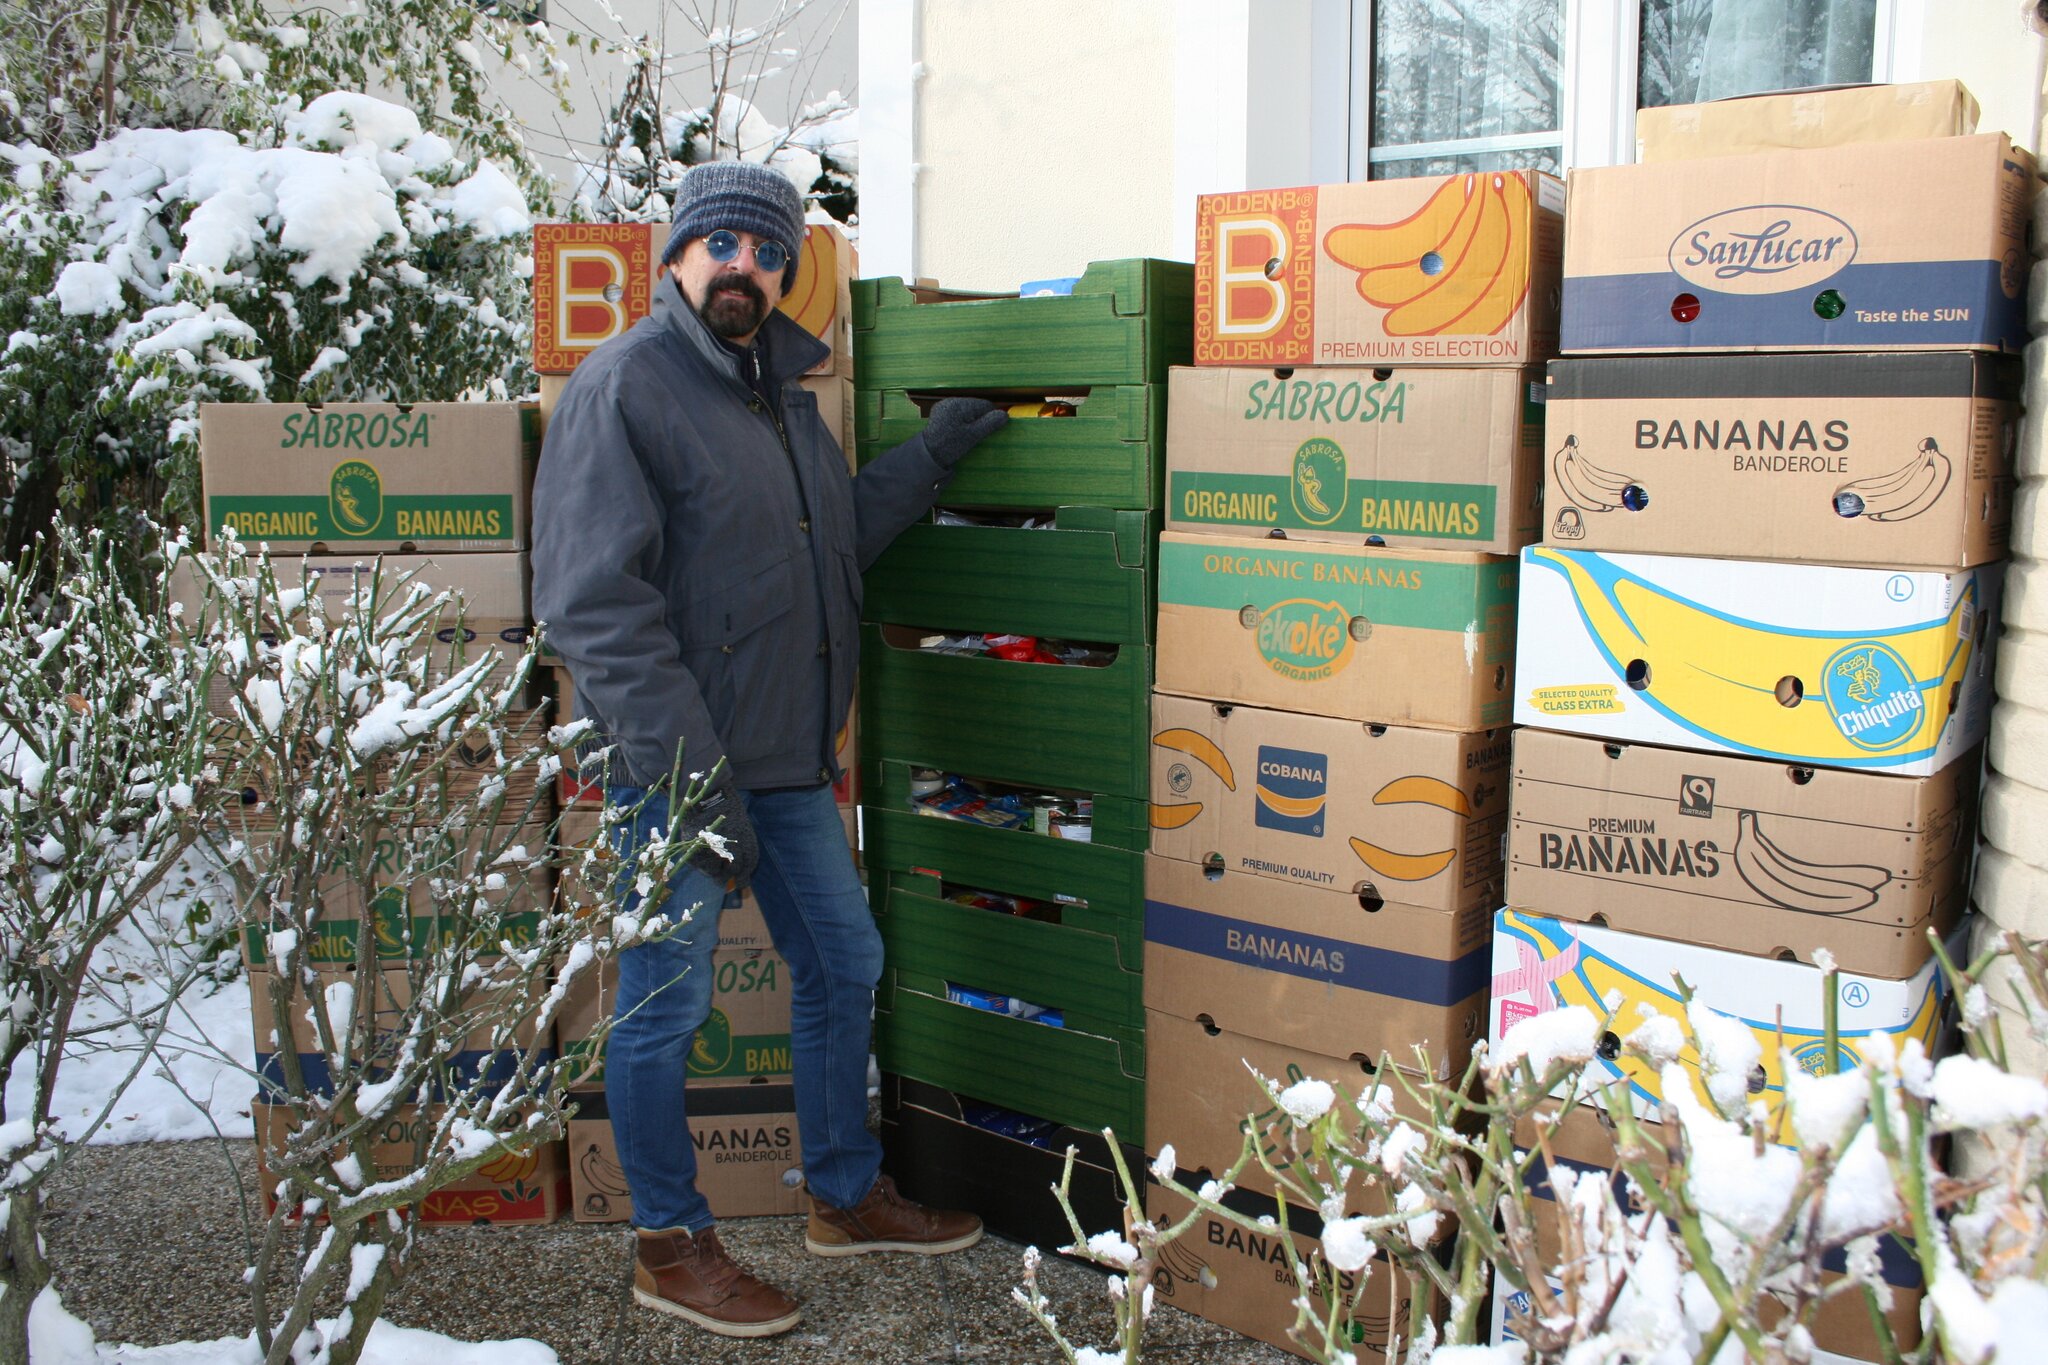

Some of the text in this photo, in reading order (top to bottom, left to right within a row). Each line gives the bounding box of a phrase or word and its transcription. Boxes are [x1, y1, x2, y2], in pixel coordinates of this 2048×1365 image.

[1198, 193, 1277, 216] GOLDEN
[537, 226, 613, 242] GOLDEN
[1685, 220, 1843, 278] SanLucar
[1213, 213, 1293, 341] B
[554, 243, 629, 352] B
[1197, 251, 1211, 342] GOLDEN
[1294, 245, 1311, 340] GOLDEN
[537, 272, 552, 352] GOLDEN
[1855, 308, 1969, 323] Taste the SUN
[1197, 341, 1273, 361] GOLDEN
[1322, 341, 1406, 358] PREMIUM
[1412, 339, 1518, 357] SELECTION
[1244, 379, 1407, 424] SABROSA
[281, 412, 430, 450] SABROSA
[1635, 418, 1849, 452] BANANAS
[1299, 443, 1343, 464] SABROSA
[1733, 455, 1848, 474] BANDEROLE
[224, 509, 501, 536] ORGANIC BANANAS
[1184, 490, 1480, 536] ORGANIC BANANAS
[1204, 554, 1422, 590] ORGANIC BANANAS
[1273, 661, 1332, 681] ORGANIC
[1539, 689, 1613, 699] SELECTED QUALITY
[1543, 699, 1614, 711] CLASS EXTRA
[1838, 690, 1922, 736] Chiquita
[1260, 761, 1323, 784] COBANA
[1679, 807, 1711, 817] FAIRTRADE
[1588, 817, 1656, 835] PREMIUM
[1540, 833, 1720, 878] BANANAS
[1242, 858, 1335, 884] PREMIUM QUALITY
[1227, 928, 1345, 974] BANANAS
[715, 1150, 792, 1164] BANDEROLE
